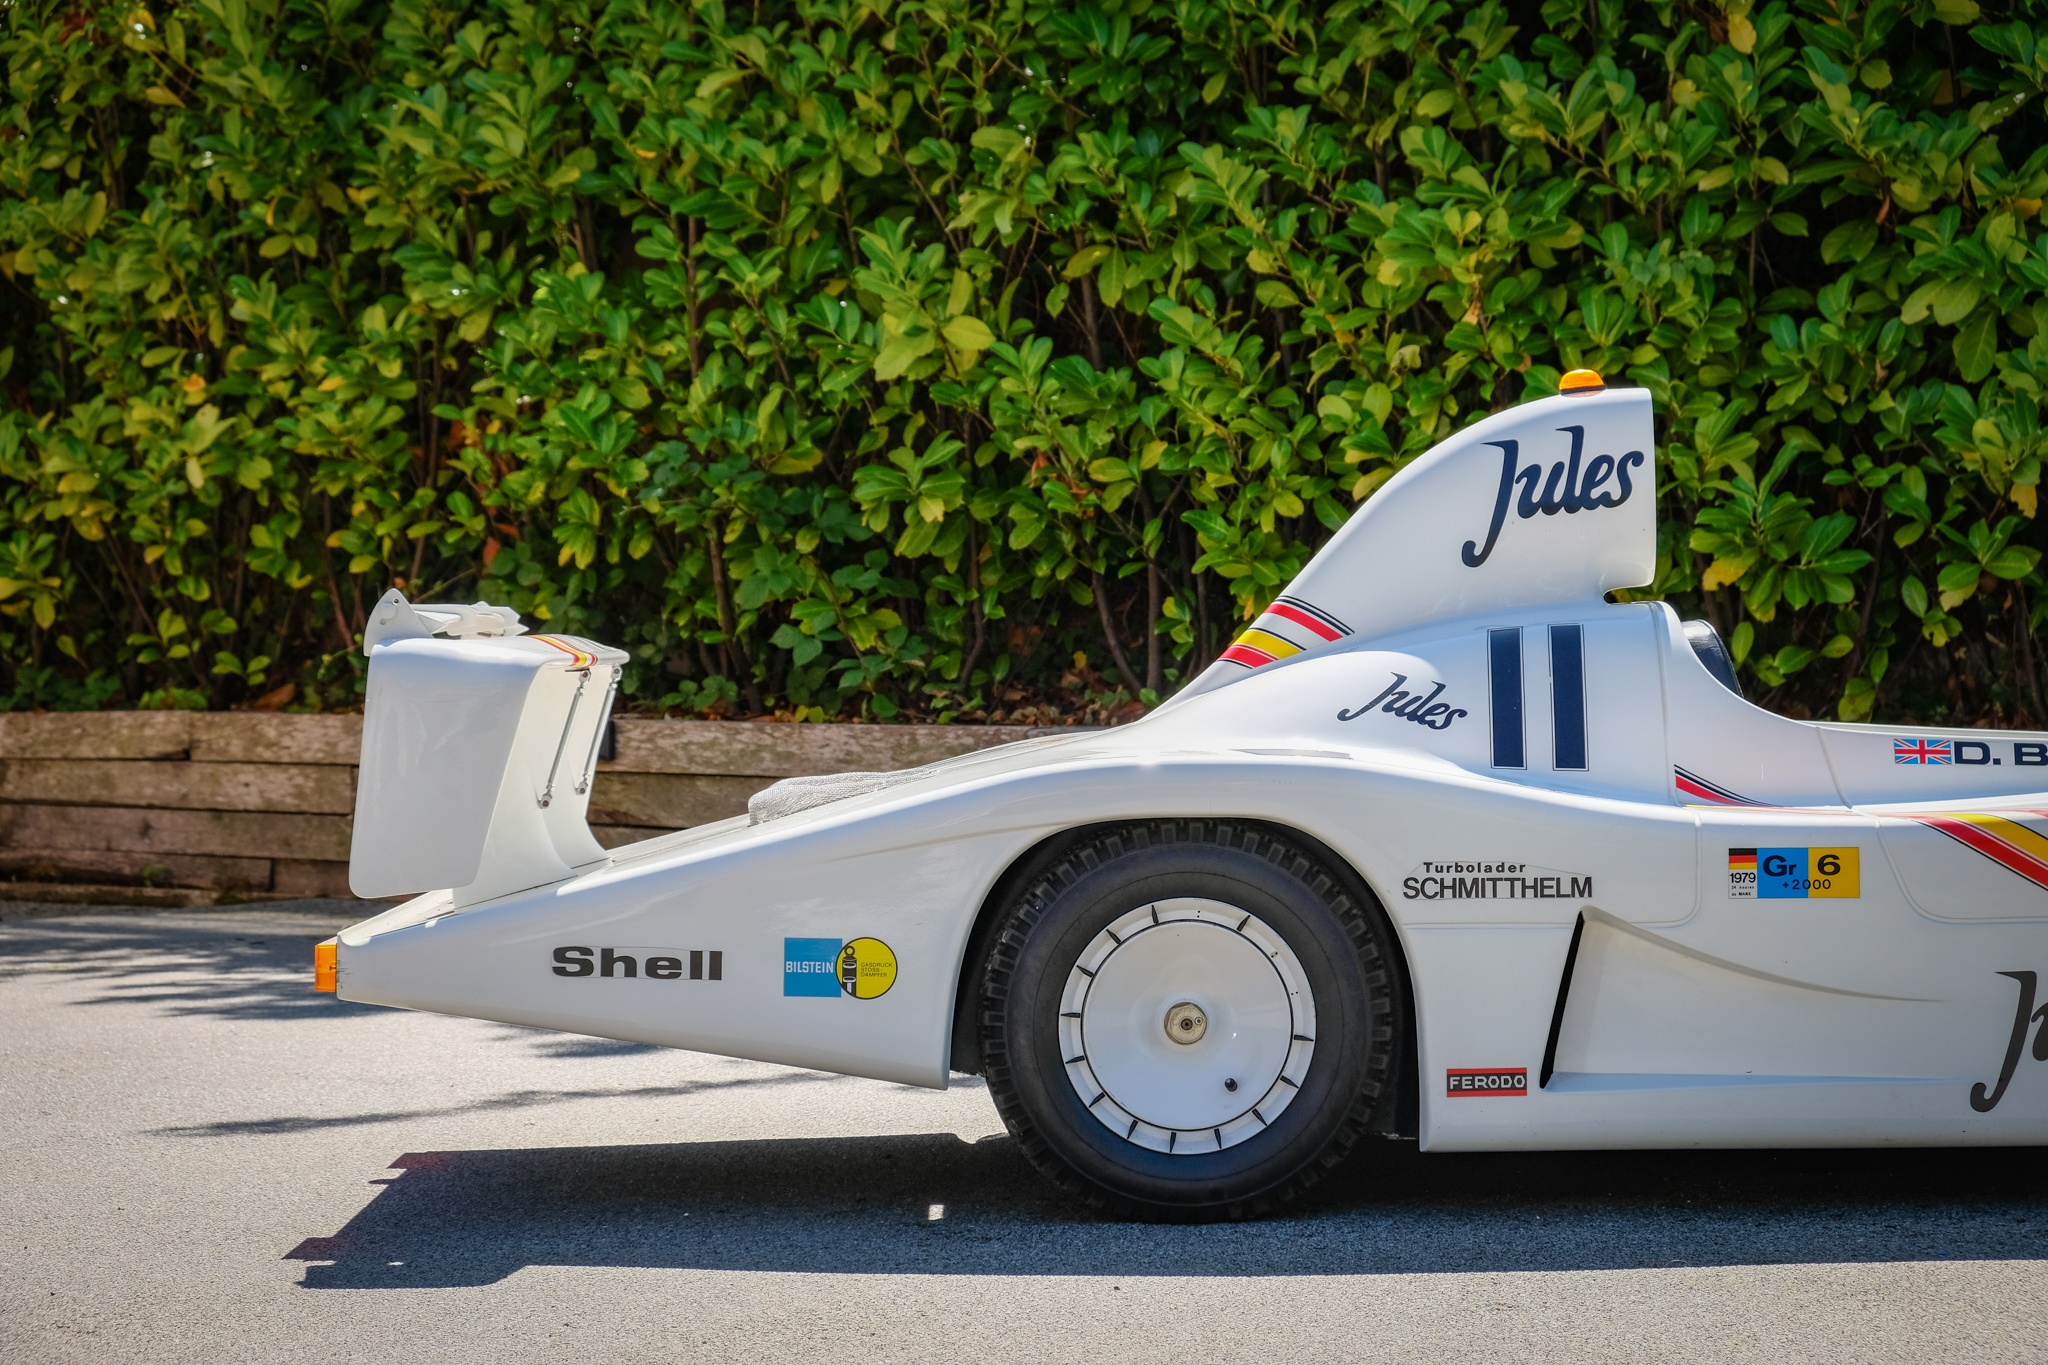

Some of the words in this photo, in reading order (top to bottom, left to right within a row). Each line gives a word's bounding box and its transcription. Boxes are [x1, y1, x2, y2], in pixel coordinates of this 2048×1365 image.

[1461, 425, 1645, 568] Jules
[1337, 672, 1468, 730] Jules
[1954, 741, 2001, 765] D.
[1423, 862, 1526, 874] Turbolader
[1763, 855, 1797, 877] Gr
[1817, 854, 1841, 876] 6
[1403, 877, 1593, 899] SCHMITTHELM
[1729, 872, 1756, 884] 1979
[552, 946, 722, 980] Shell
[785, 961, 834, 973] BILSTEIN
[1449, 1075, 1526, 1090] FERODO
